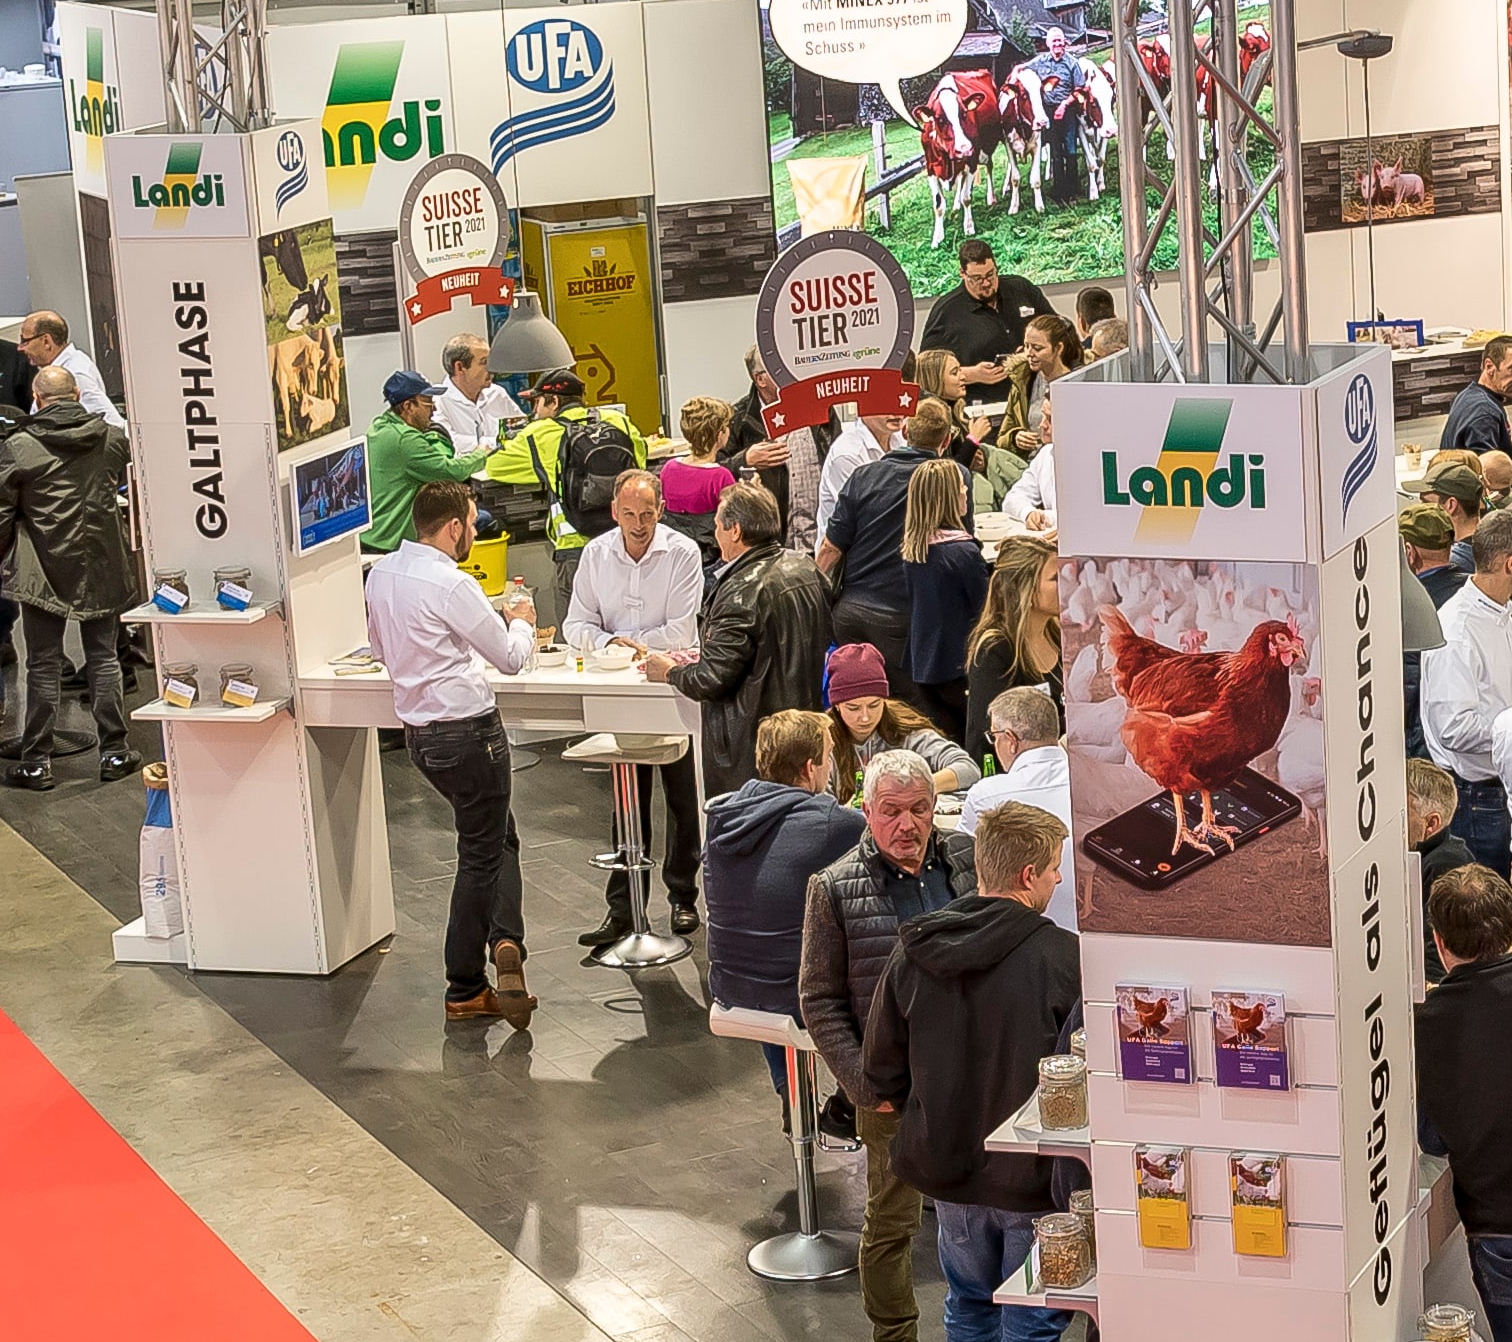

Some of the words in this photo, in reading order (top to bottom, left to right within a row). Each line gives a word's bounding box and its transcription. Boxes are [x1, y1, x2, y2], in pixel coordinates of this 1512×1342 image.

[803, 18, 836, 33] mein
[840, 11, 933, 33] Immunsystem
[935, 10, 952, 23] im
[515, 20, 594, 90] UFA
[70, 78, 120, 137] Landi
[278, 134, 303, 170] UFA
[131, 173, 226, 208] Landi
[422, 187, 484, 223] SUISSE
[424, 220, 464, 253] TIER
[465, 217, 486, 234] 2021
[441, 272, 480, 291] NEUHEIT
[567, 275, 636, 297] EICHHOF
[790, 270, 878, 315] SUISSE
[792, 311, 848, 351] TIER
[851, 307, 880, 328] 2021
[171, 279, 229, 541] GALTPHASE
[815, 376, 871, 400] NEUHEIT
[1347, 374, 1374, 441] UFA
[1101, 450, 1267, 509] Landi
[1353, 535, 1378, 842] Chance
[1361, 861, 1384, 973] als
[1363, 991, 1390, 1307] Geflügel
